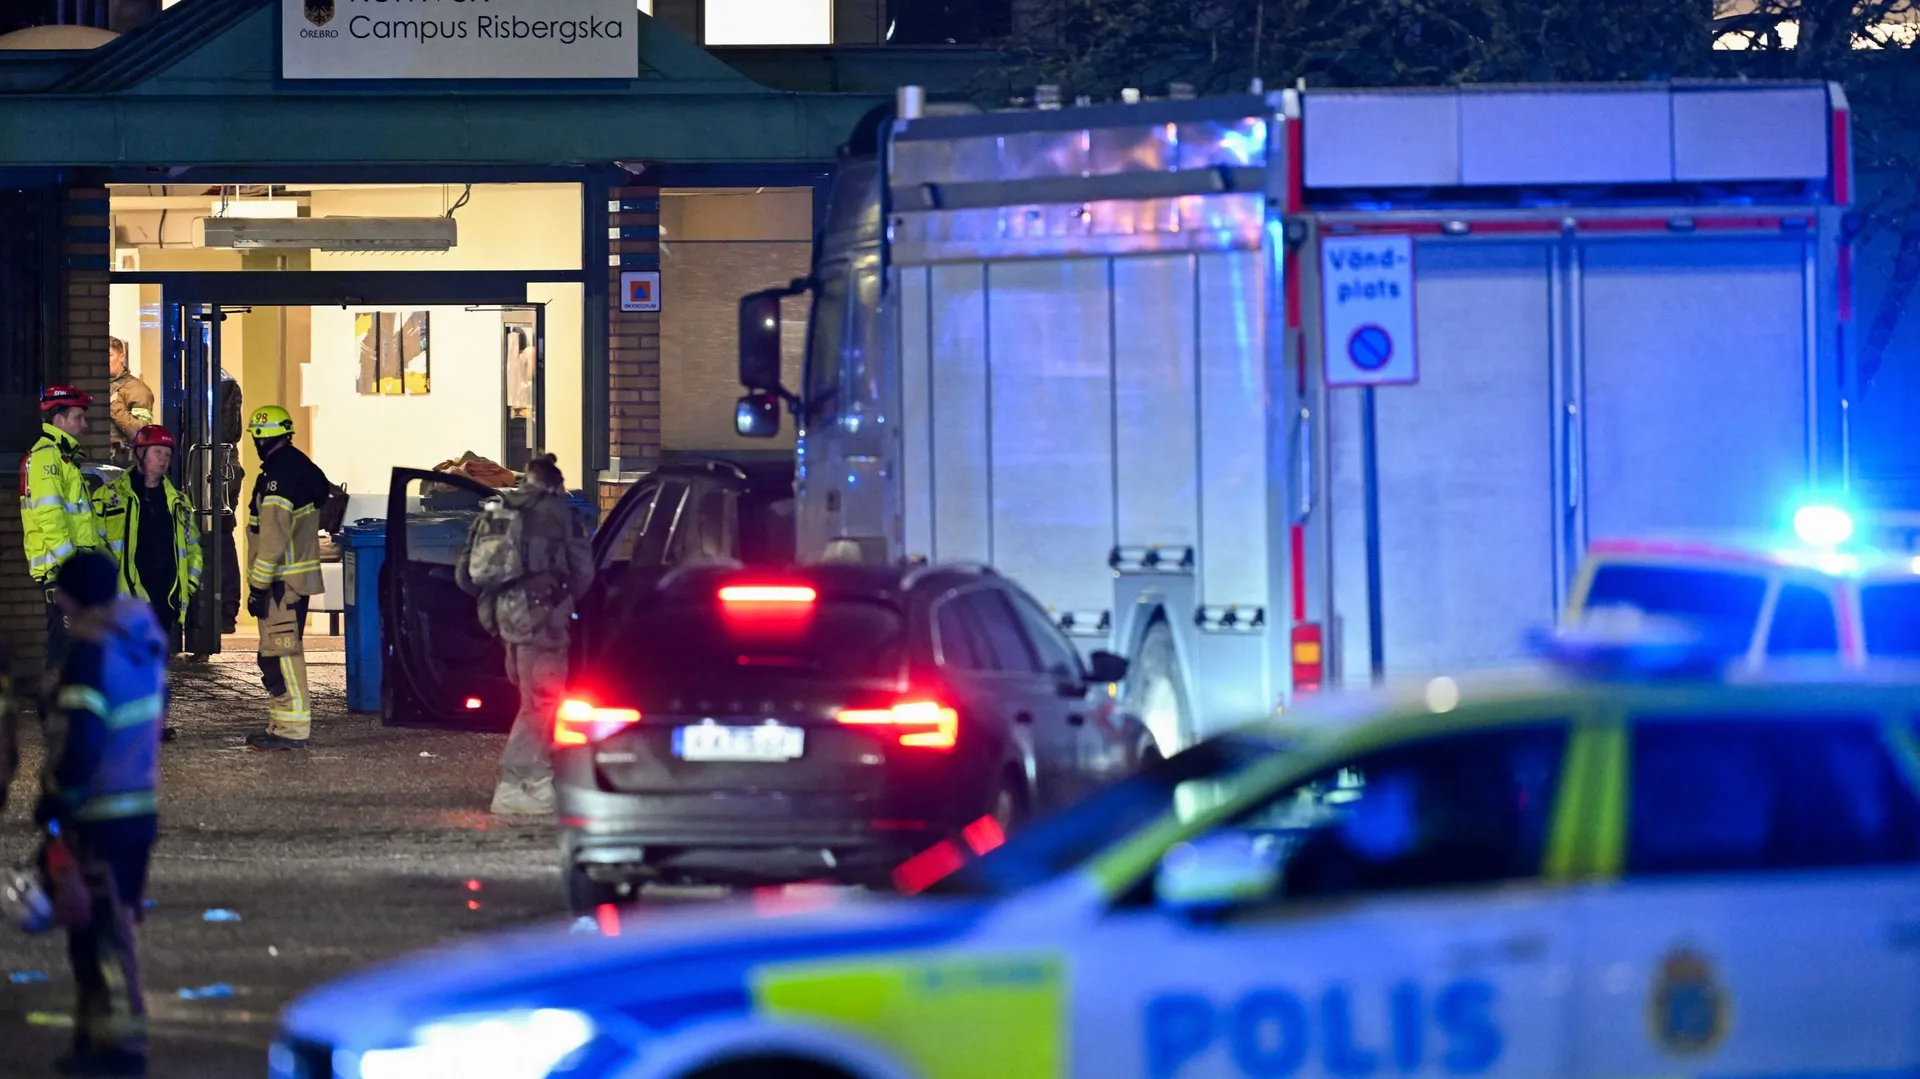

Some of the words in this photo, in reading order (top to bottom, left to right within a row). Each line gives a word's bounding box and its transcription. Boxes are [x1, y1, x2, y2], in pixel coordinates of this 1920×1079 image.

[299, 28, 339, 39] ÖREBRO
[349, 15, 467, 44] Campus
[477, 15, 622, 44] Risbergska
[1337, 278, 1401, 304] plats
[255, 412, 269, 424] 98
[275, 636, 292, 649] 98
[1142, 978, 1506, 1079] POLIS
